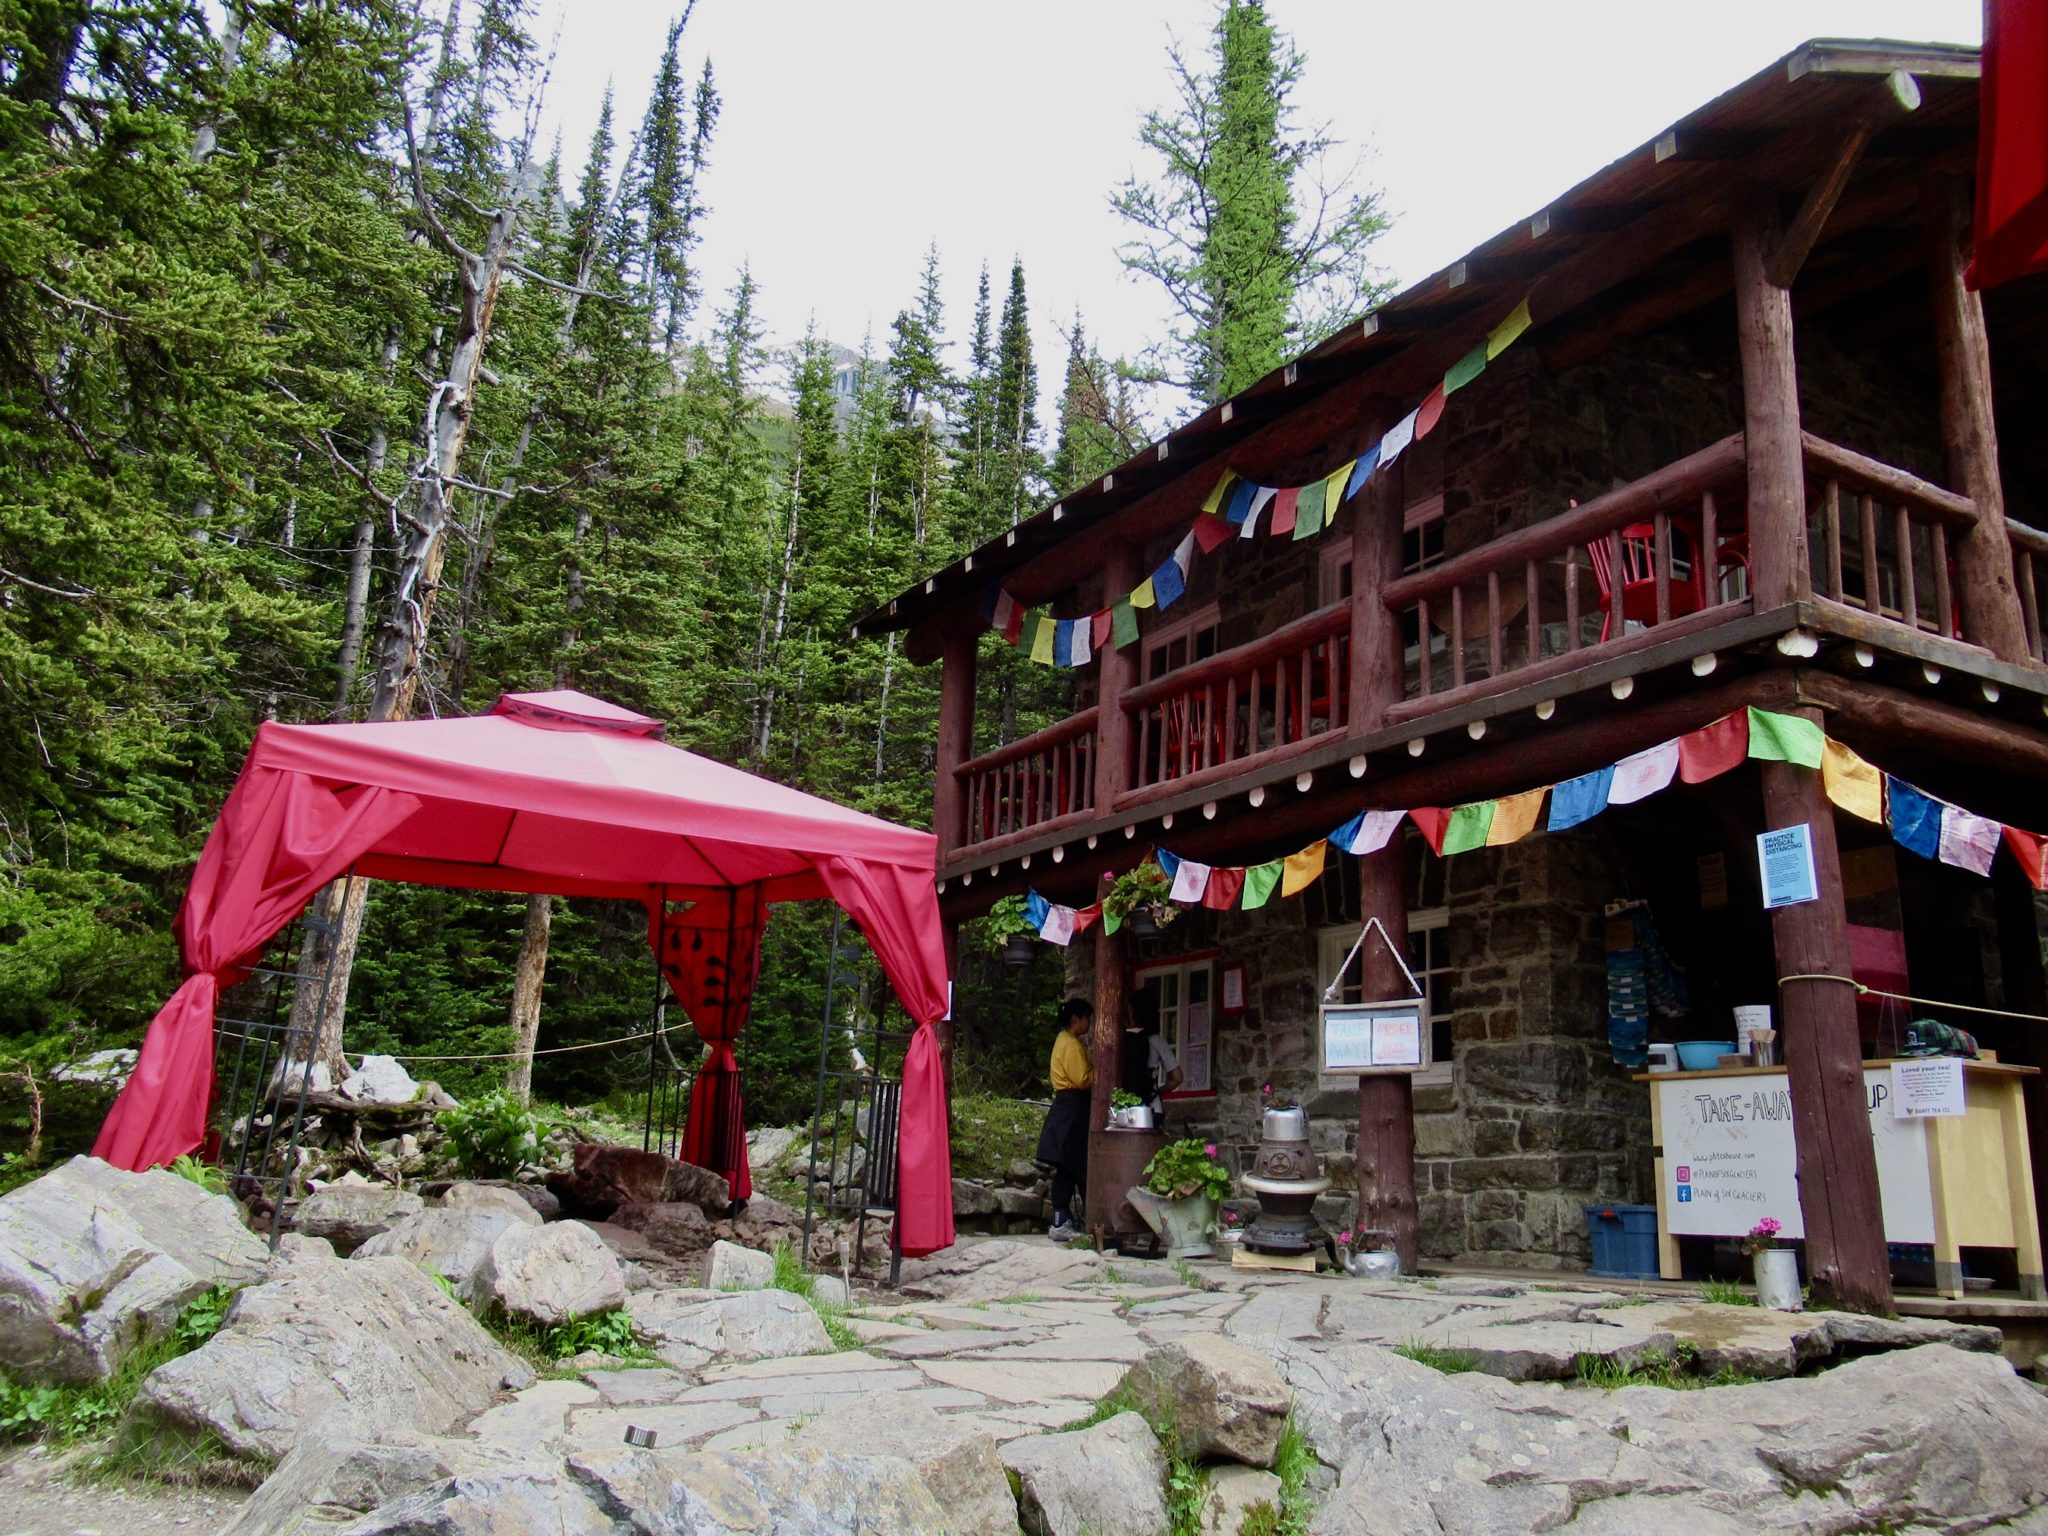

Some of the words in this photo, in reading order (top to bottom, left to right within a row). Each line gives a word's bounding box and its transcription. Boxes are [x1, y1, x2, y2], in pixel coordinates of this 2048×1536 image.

[1764, 833, 1794, 843] PRACTICE
[1765, 838, 1794, 849] PHYSICAL
[1765, 841, 1802, 855] DISTANCING
[1330, 1022, 1365, 1036] TAKE
[1921, 1065, 1936, 1073] your
[1693, 1187, 1712, 1198] PLAIN
[1732, 1189, 1767, 1203] GLACIERS
